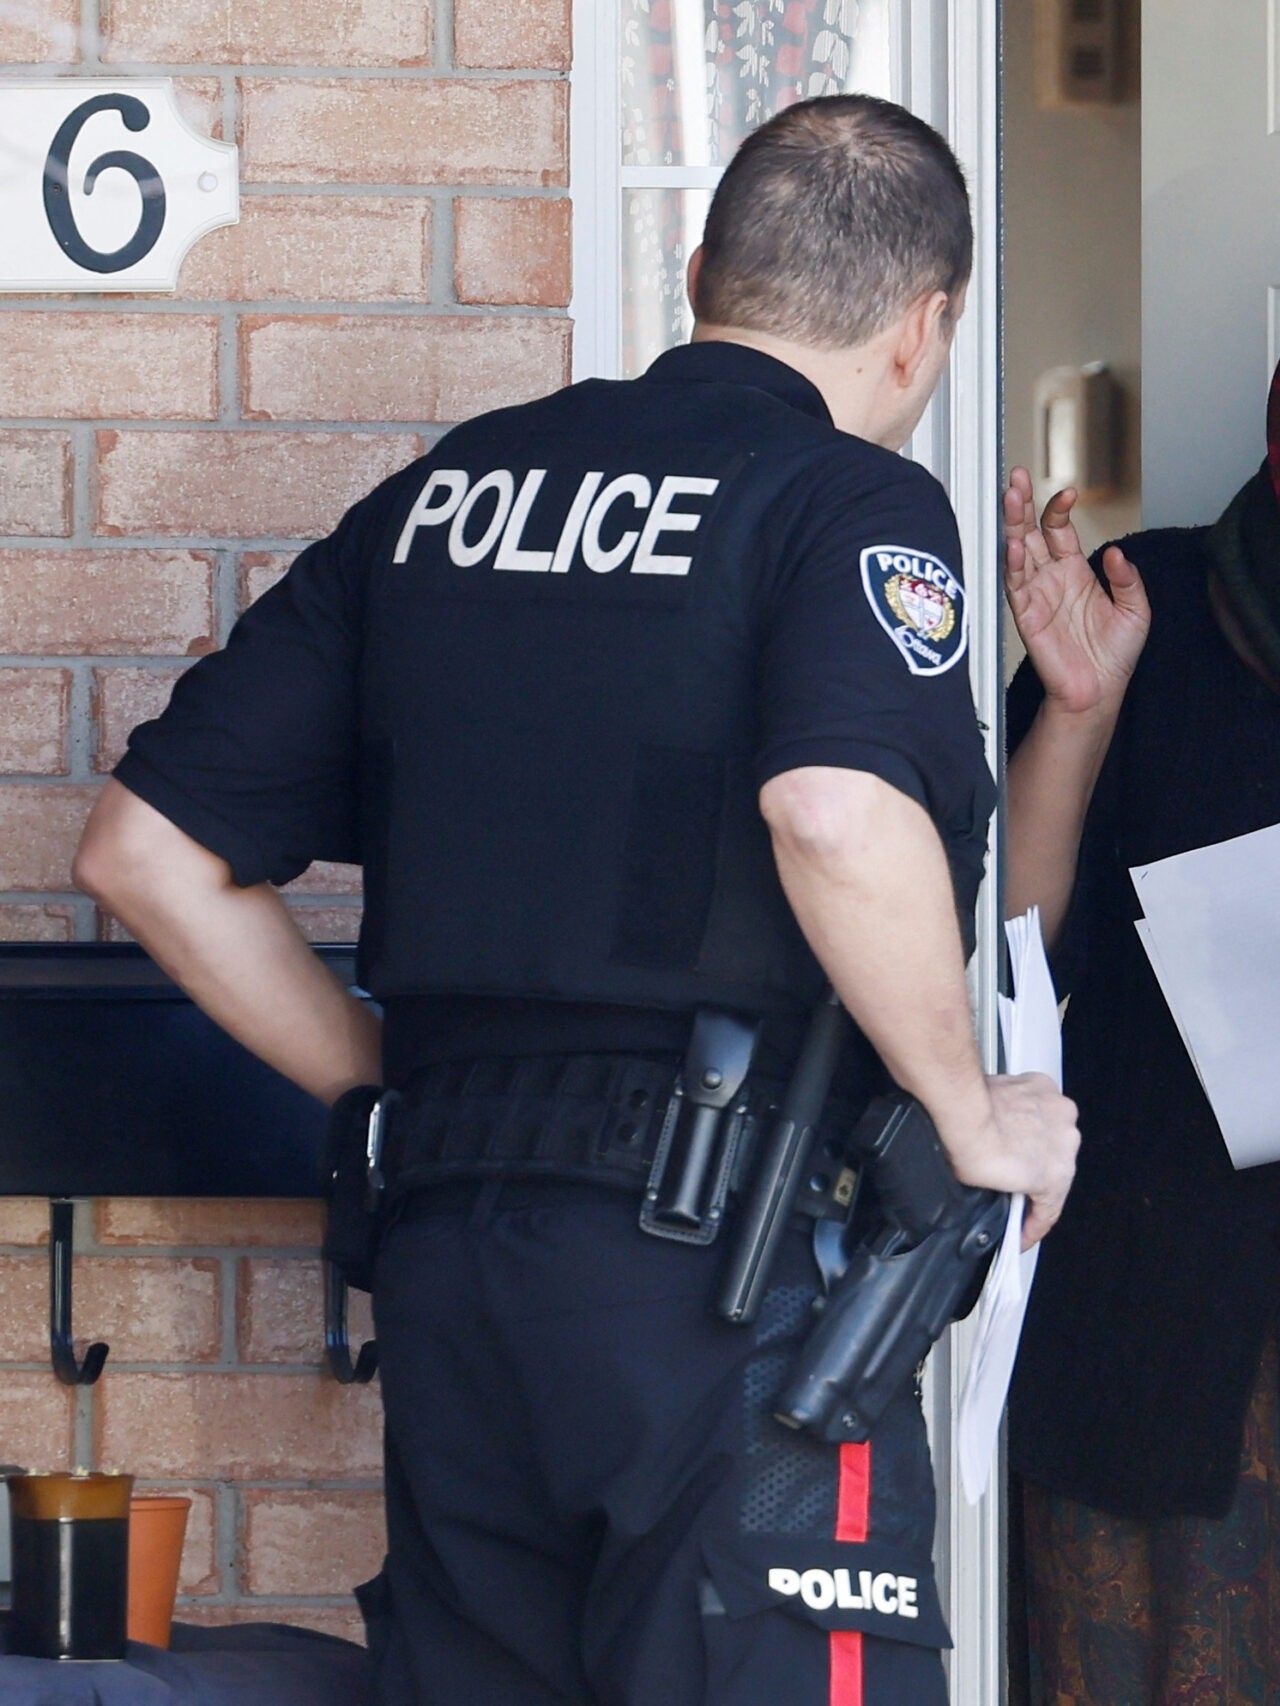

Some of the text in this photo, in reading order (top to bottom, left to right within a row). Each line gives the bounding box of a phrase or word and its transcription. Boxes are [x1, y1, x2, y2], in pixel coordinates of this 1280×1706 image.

[43, 92, 166, 275] 6
[393, 468, 720, 576] POLICE
[876, 552, 958, 600] POLICE
[768, 1567, 919, 1619] POLICE
